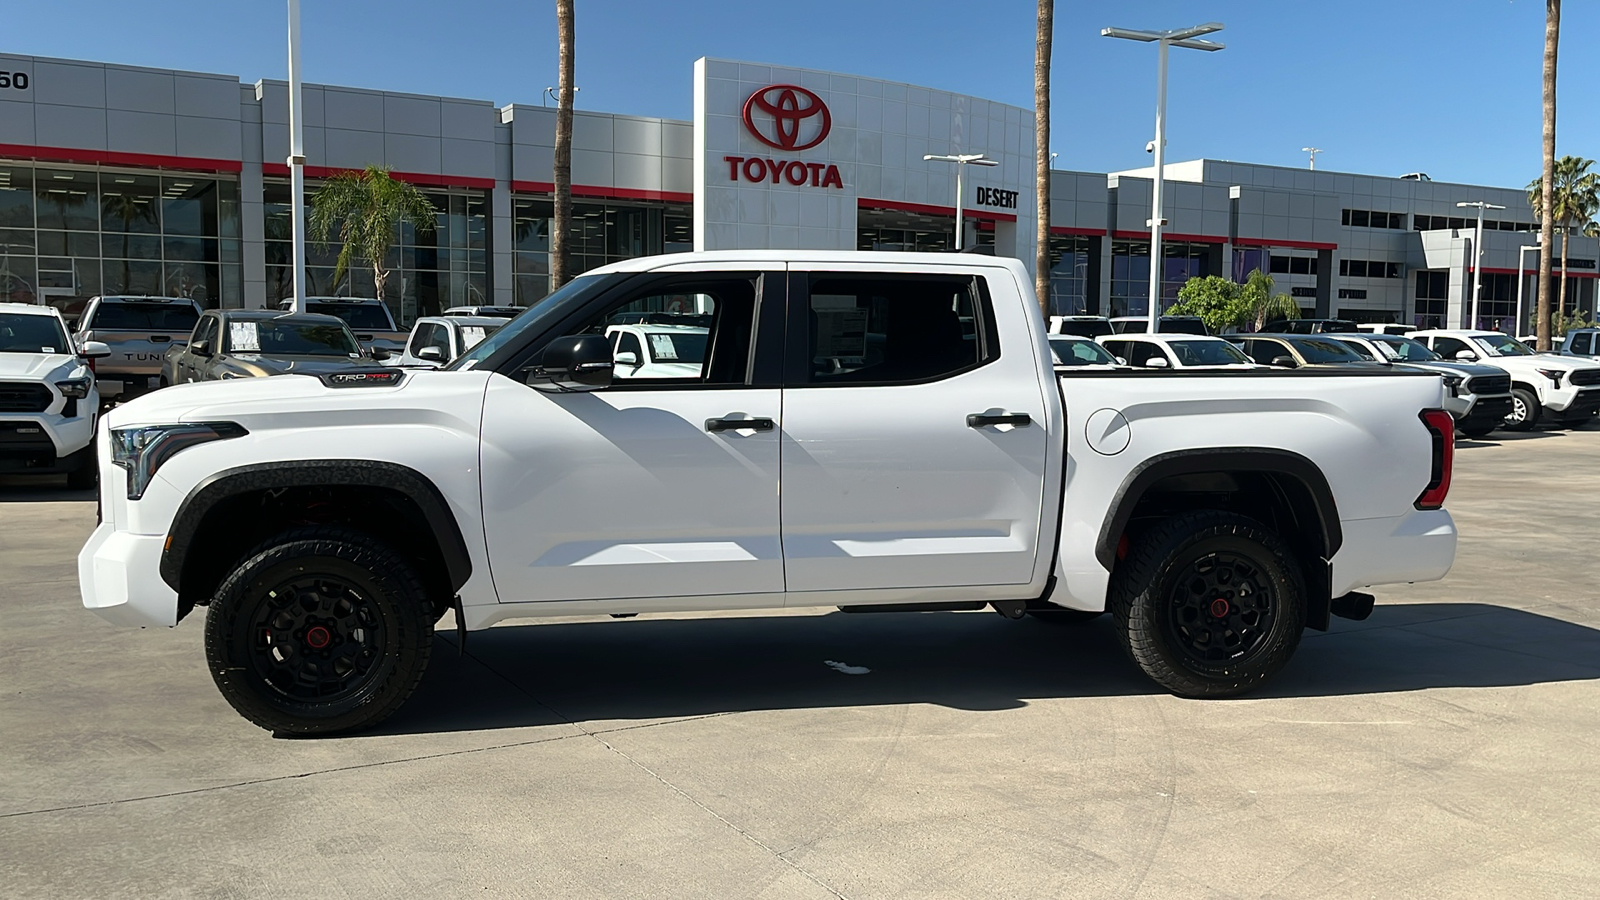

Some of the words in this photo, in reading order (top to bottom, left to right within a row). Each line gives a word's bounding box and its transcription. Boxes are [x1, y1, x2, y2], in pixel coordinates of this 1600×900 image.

[0, 71, 29, 90] 50
[723, 156, 844, 189] TOYOTA
[977, 186, 1019, 209] DESERT
